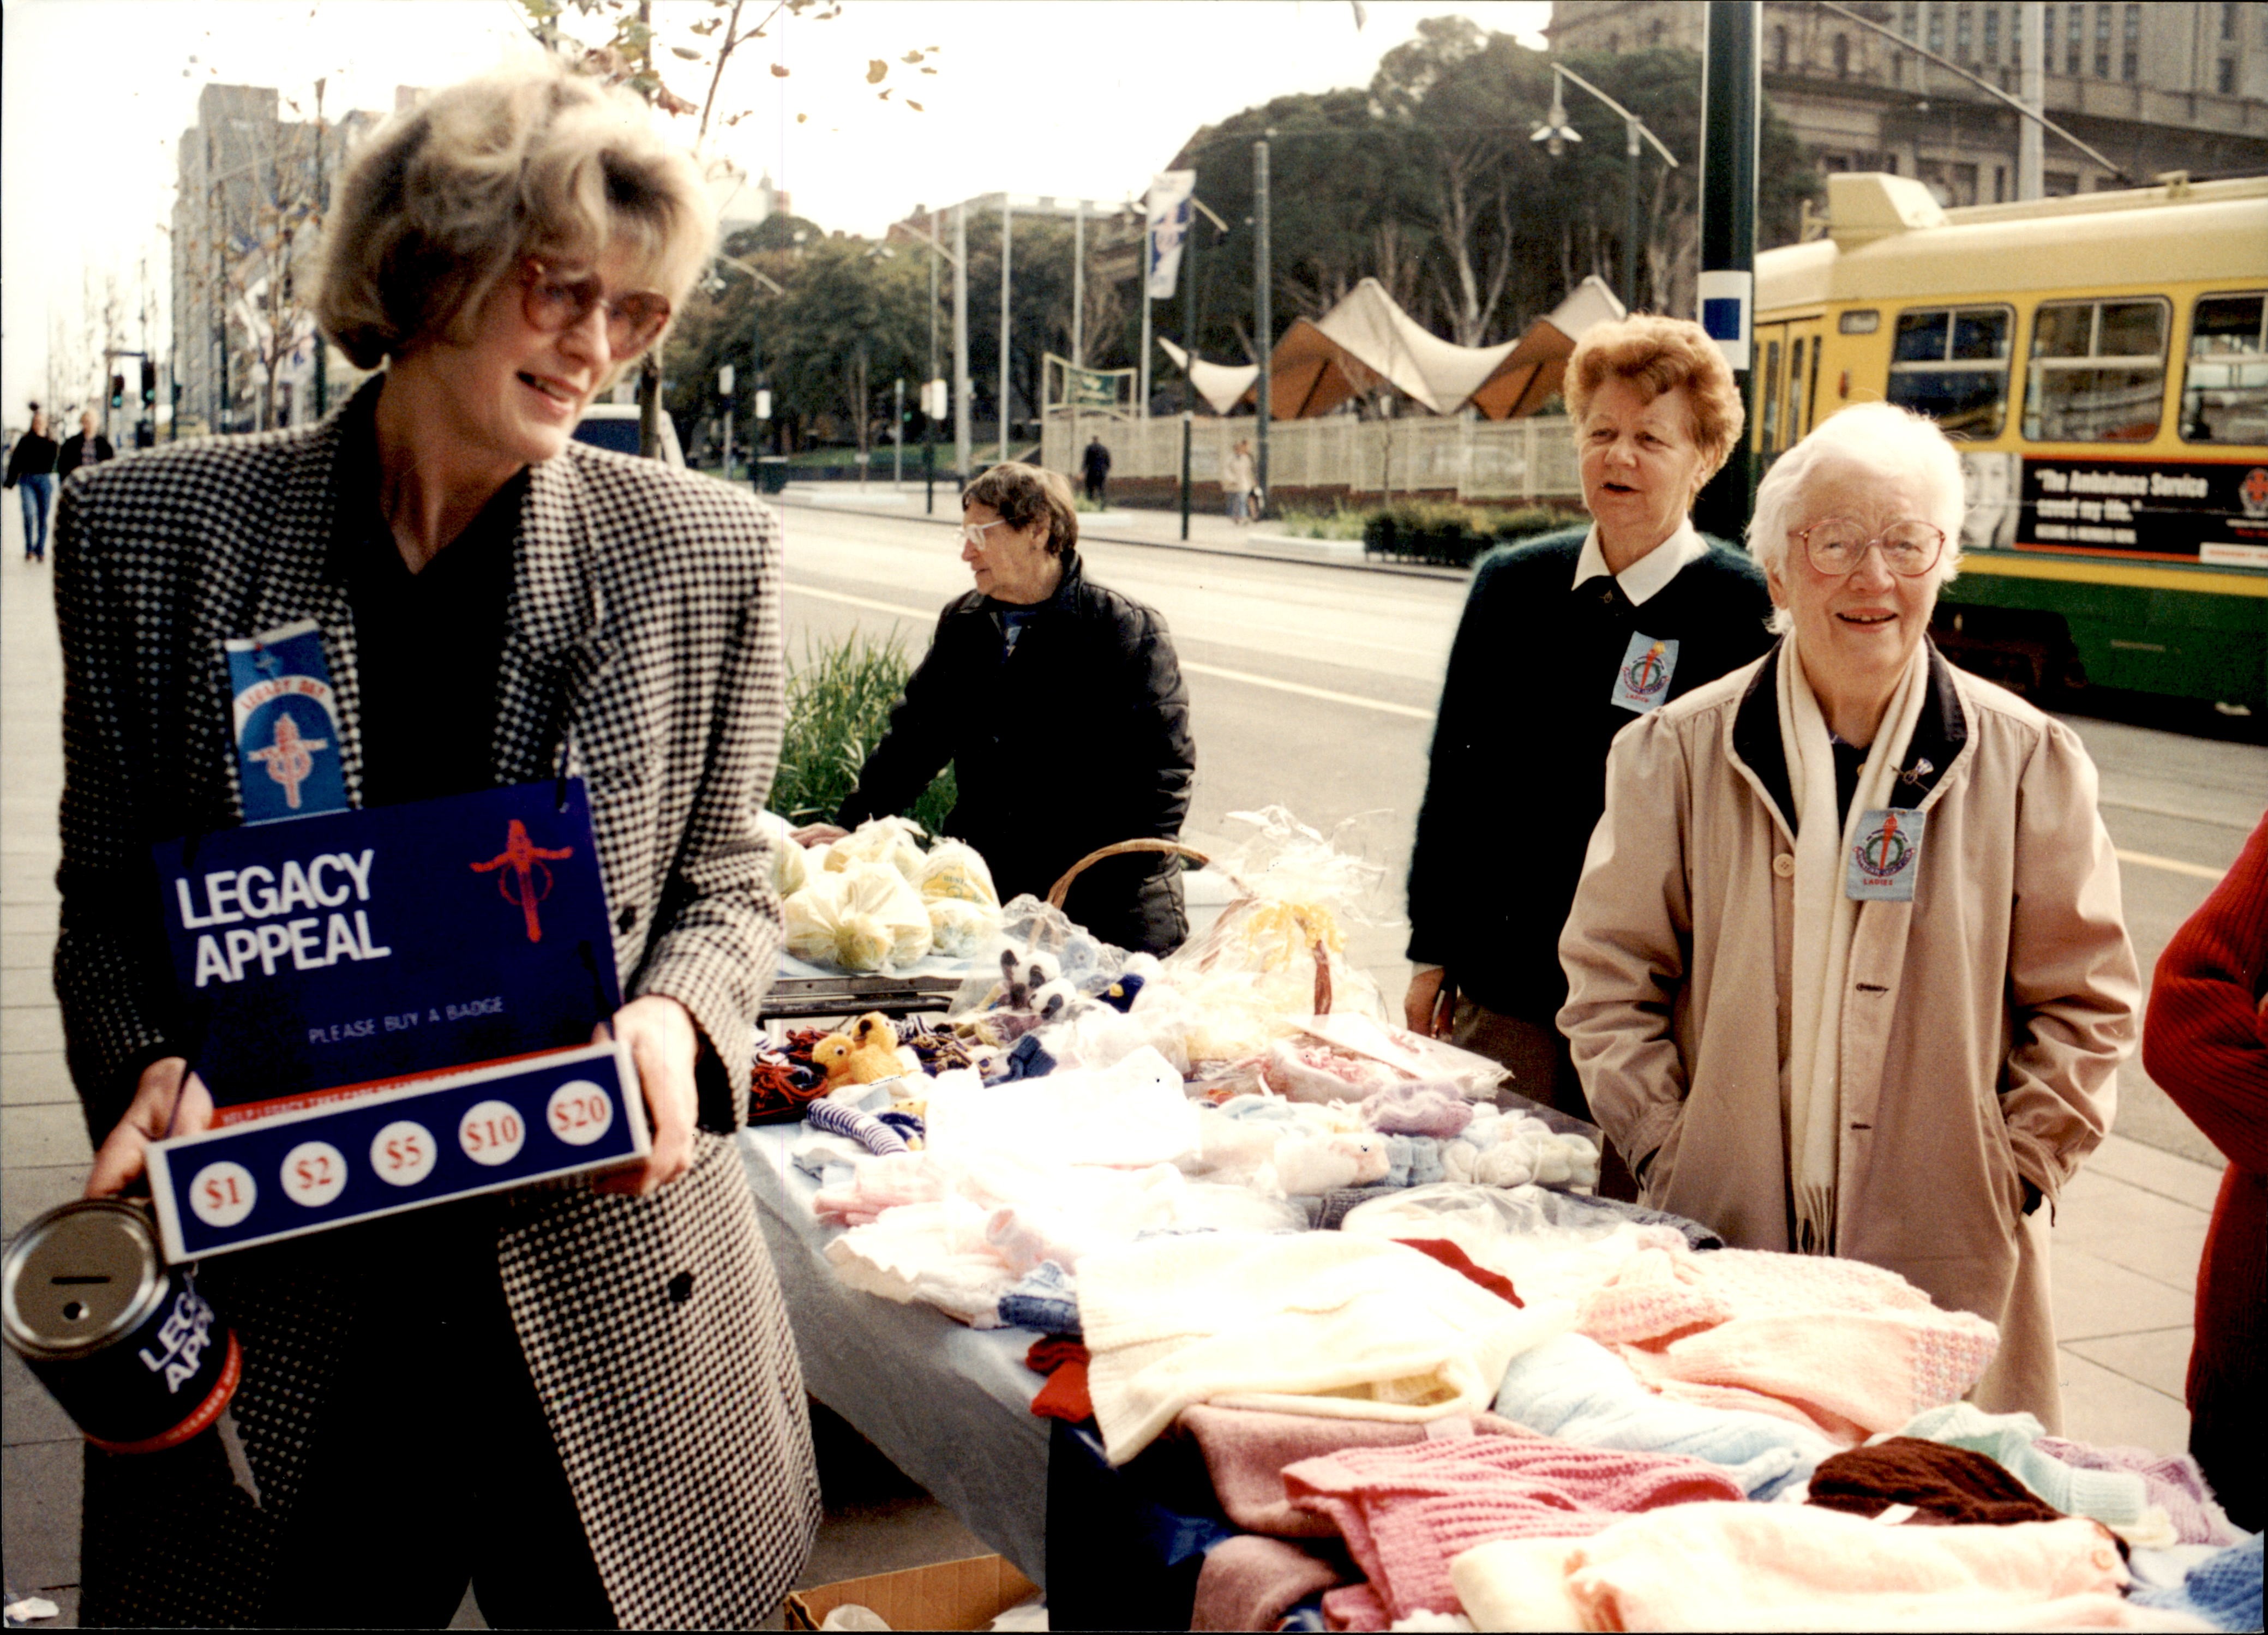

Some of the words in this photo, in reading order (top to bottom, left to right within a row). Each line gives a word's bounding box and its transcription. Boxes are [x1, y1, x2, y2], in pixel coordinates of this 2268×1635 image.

[2150, 472, 2209, 498] Service
[176, 849, 374, 929] LEGACY
[195, 909, 392, 987] APPEAL
[308, 1018, 376, 1044] PLEASE
[384, 1012, 419, 1031] BUY
[428, 1008, 441, 1022] A
[446, 996, 503, 1021] BADGE
[205, 1177, 240, 1209] $1
[296, 1157, 331, 1189] $2
[386, 1137, 421, 1169] $5
[466, 1116, 517, 1151] $10
[554, 1097, 605, 1131] $20
